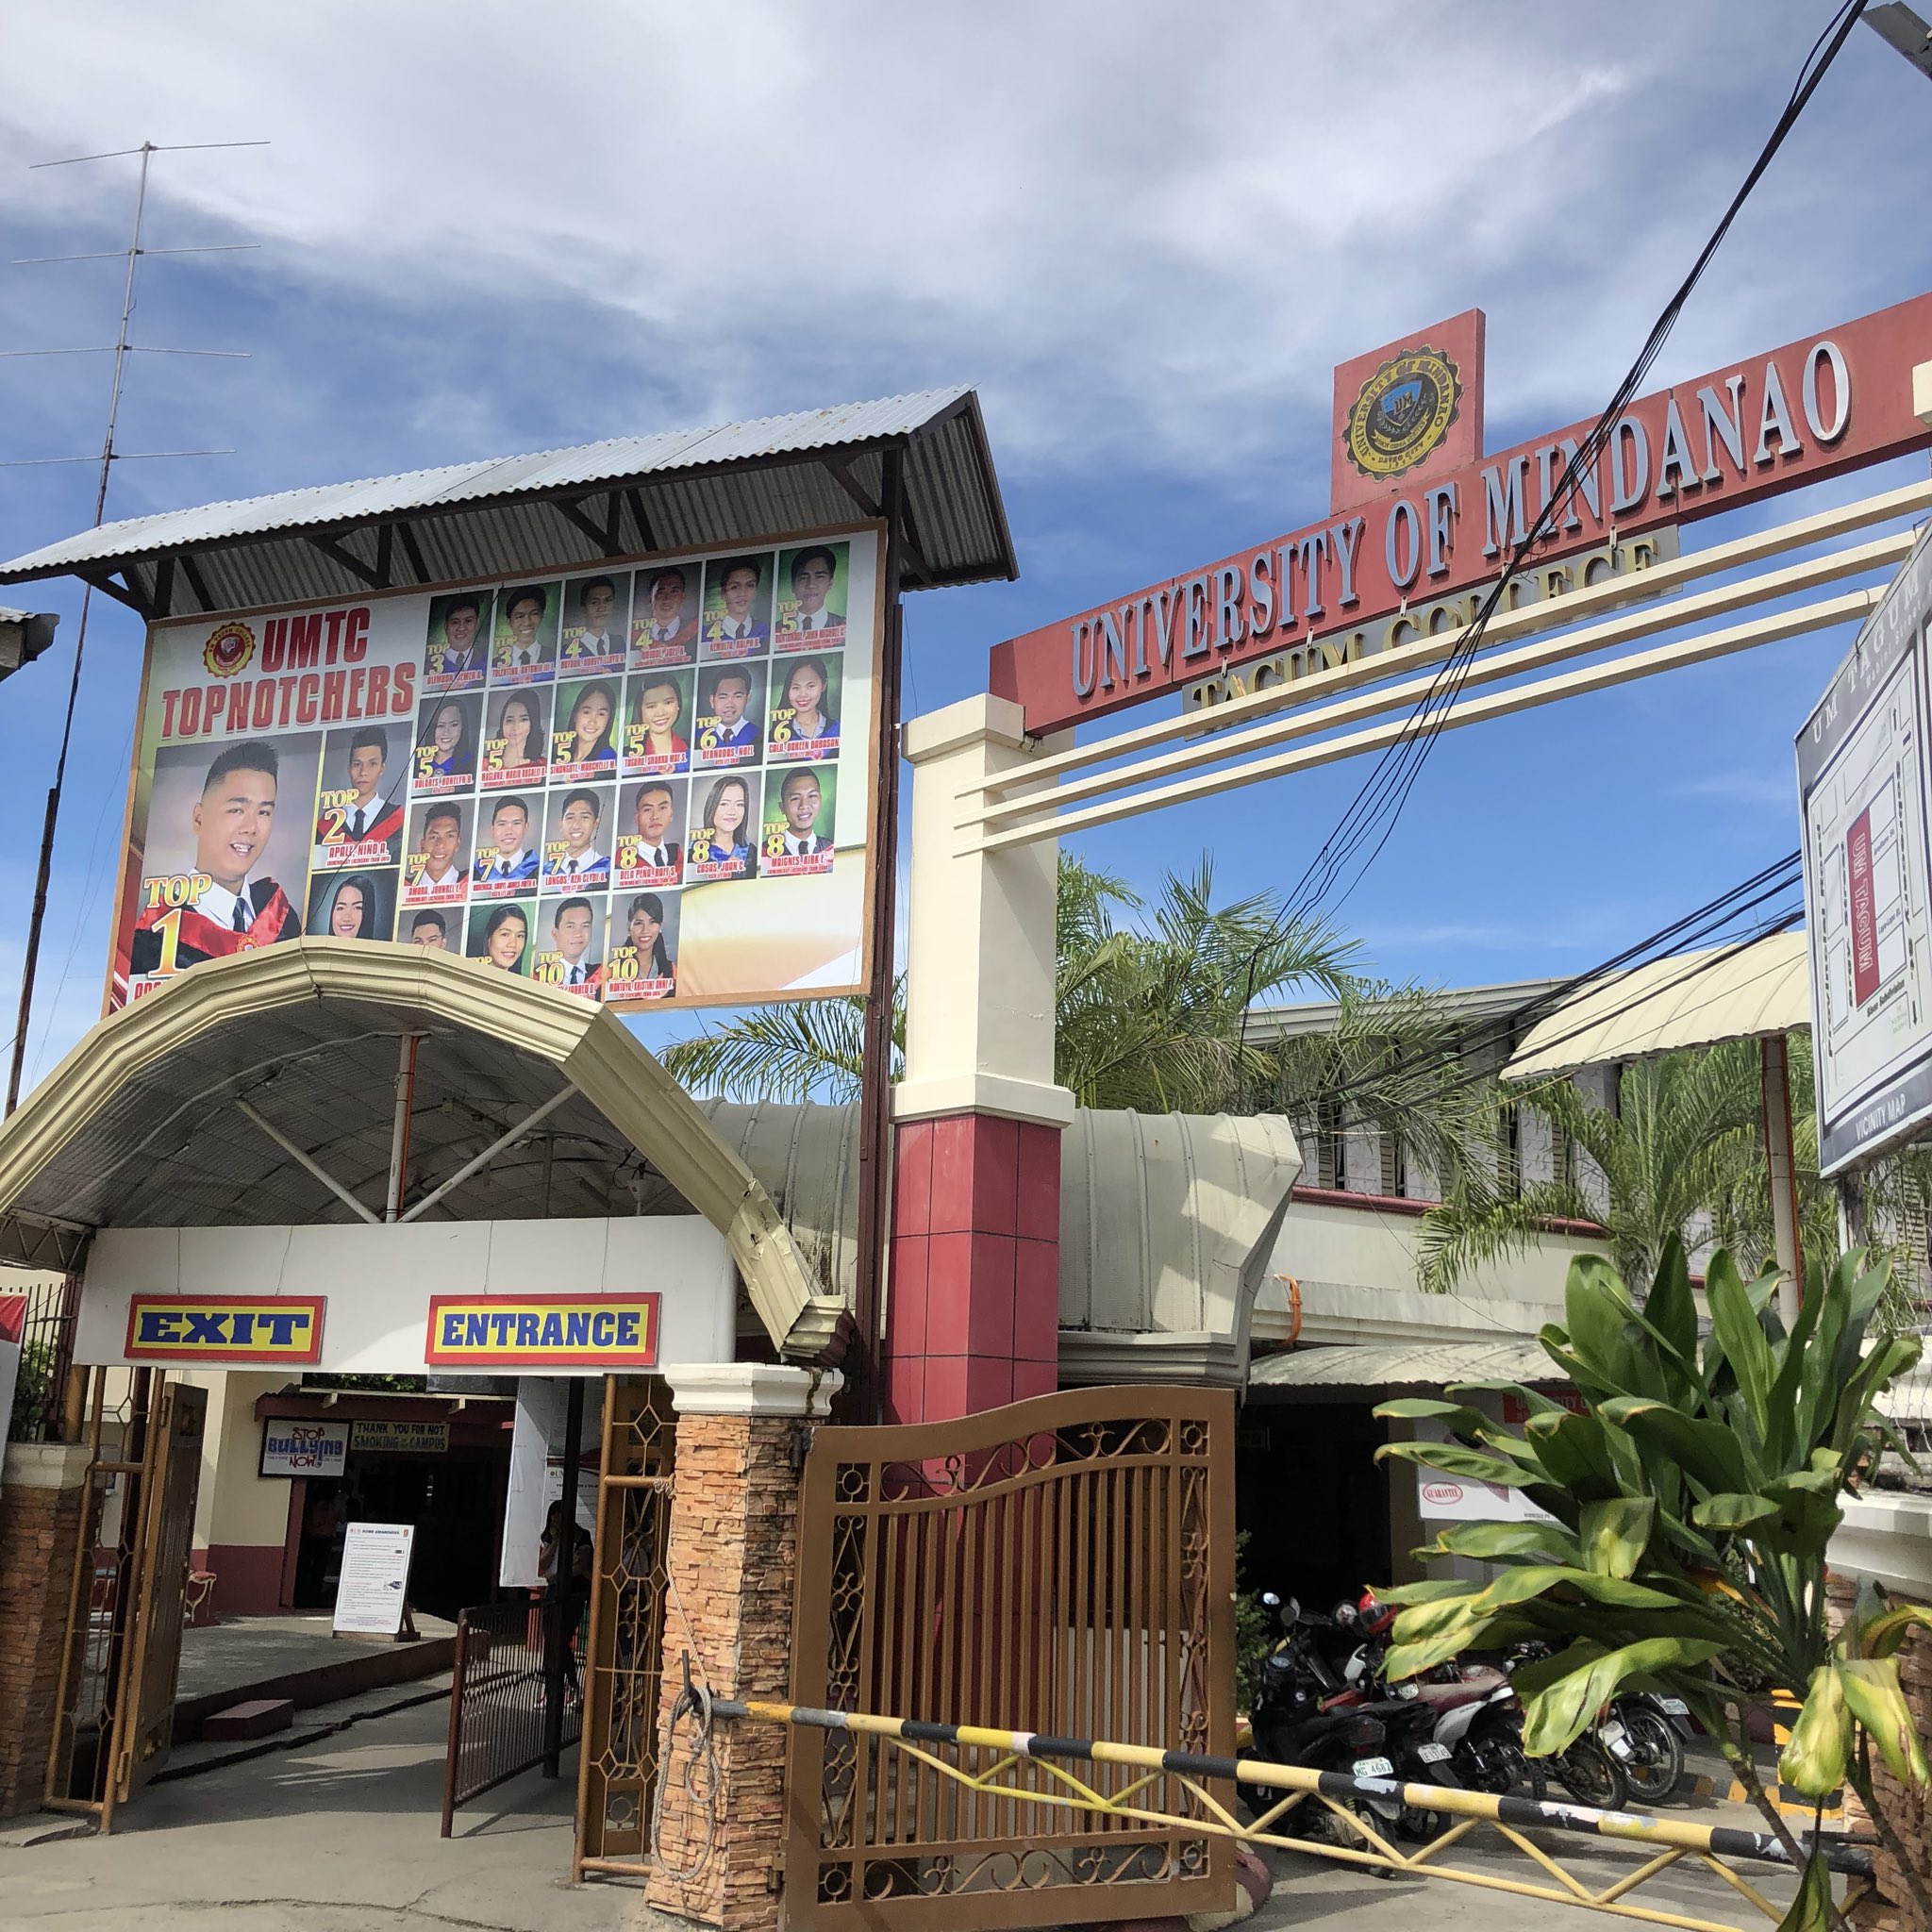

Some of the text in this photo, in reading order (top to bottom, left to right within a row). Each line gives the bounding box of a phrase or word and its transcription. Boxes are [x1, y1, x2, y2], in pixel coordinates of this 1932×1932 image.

[1355, 370, 1393, 458] UNIVERSITY
[1072, 340, 1852, 699] UNIVERSITY OF MINDANAO
[704, 608, 729, 623] TOP
[776, 600, 803, 613] TOP
[562, 626, 588, 641] TOP
[632, 617, 658, 630] TOP
[707, 620, 724, 642] 4
[781, 610, 799, 635] 5
[261, 608, 370, 673] UMTC
[427, 641, 450, 656] TOP
[494, 636, 518, 648] TOP
[565, 638, 583, 660] 4
[635, 629, 653, 652] 4
[429, 654, 445, 675] 3
[496, 646, 513, 668] 3
[1811, 569, 1919, 743] UM TAGUM
[161, 662, 415, 741] TOPNOTCHERS
[696, 715, 723, 729] TOP
[769, 707, 796, 723] TOP
[553, 730, 577, 744] TOP
[624, 723, 650, 738] TOP
[699, 727, 718, 751] 6
[773, 720, 792, 744] 6
[415, 745, 440, 758] TOP
[485, 739, 509, 752] TOP
[556, 741, 573, 766] 5
[627, 735, 645, 758] 5
[738, 746, 756, 757] NOEL
[418, 756, 434, 780] 5
[488, 750, 504, 773] 5
[321, 789, 359, 809] TOP
[322, 808, 346, 845] 2
[690, 827, 716, 841] TOP
[763, 822, 791, 836] TOP
[545, 841, 571, 854] TOP
[617, 834, 643, 848] TOP
[691, 840, 710, 864] 8
[767, 833, 786, 858] 8
[407, 853, 431, 866] TOP
[475, 847, 500, 859] TOP
[549, 852, 565, 875] 7
[620, 846, 638, 870] 8
[409, 864, 425, 888] 7
[479, 858, 496, 882] 7
[143, 874, 212, 908] TOP
[1853, 831, 1874, 974] UM TAGUM
[147, 908, 186, 978] 1
[611, 946, 638, 959] TOP
[538, 952, 564, 964] TOP
[535, 962, 565, 987] 10
[608, 958, 639, 982] 10
[1855, 1092, 1906, 1141] VICINITY MAP
[138, 1312, 310, 1345] EXIT
[441, 1311, 641, 1347] ENTRANCE
[291, 1426, 325, 1440] STOP
[357, 1423, 445, 1436] THANK YOU FOR NOT
[354, 1436, 445, 1451] SMOKING CAMPUS
[1426, 1488, 1458, 1499] GUARANTEE
